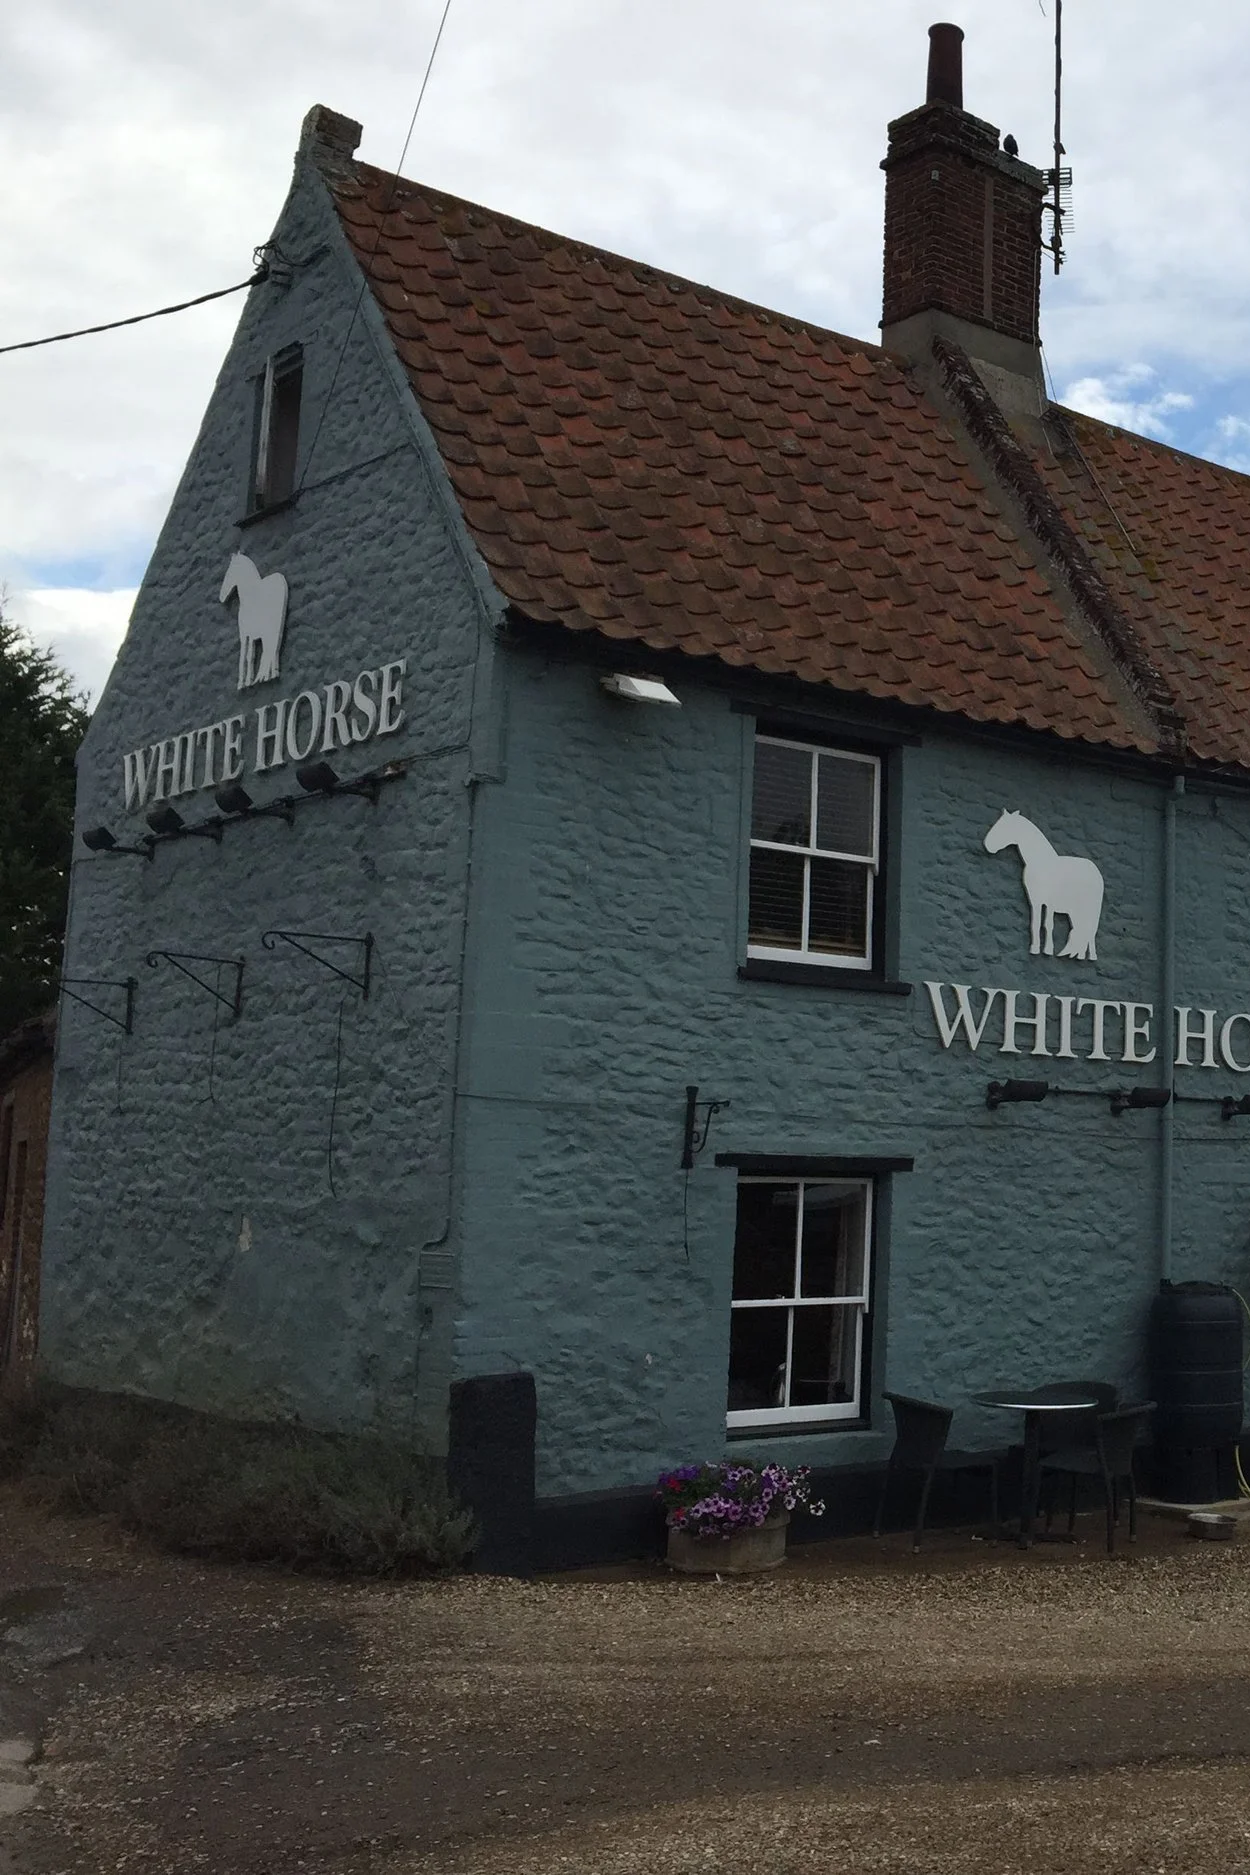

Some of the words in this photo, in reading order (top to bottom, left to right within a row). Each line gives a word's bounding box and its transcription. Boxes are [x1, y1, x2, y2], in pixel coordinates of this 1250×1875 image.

[123, 714, 246, 811] WHITE
[253, 657, 407, 773] HORSE
[922, 980, 1158, 1063] WHITE
